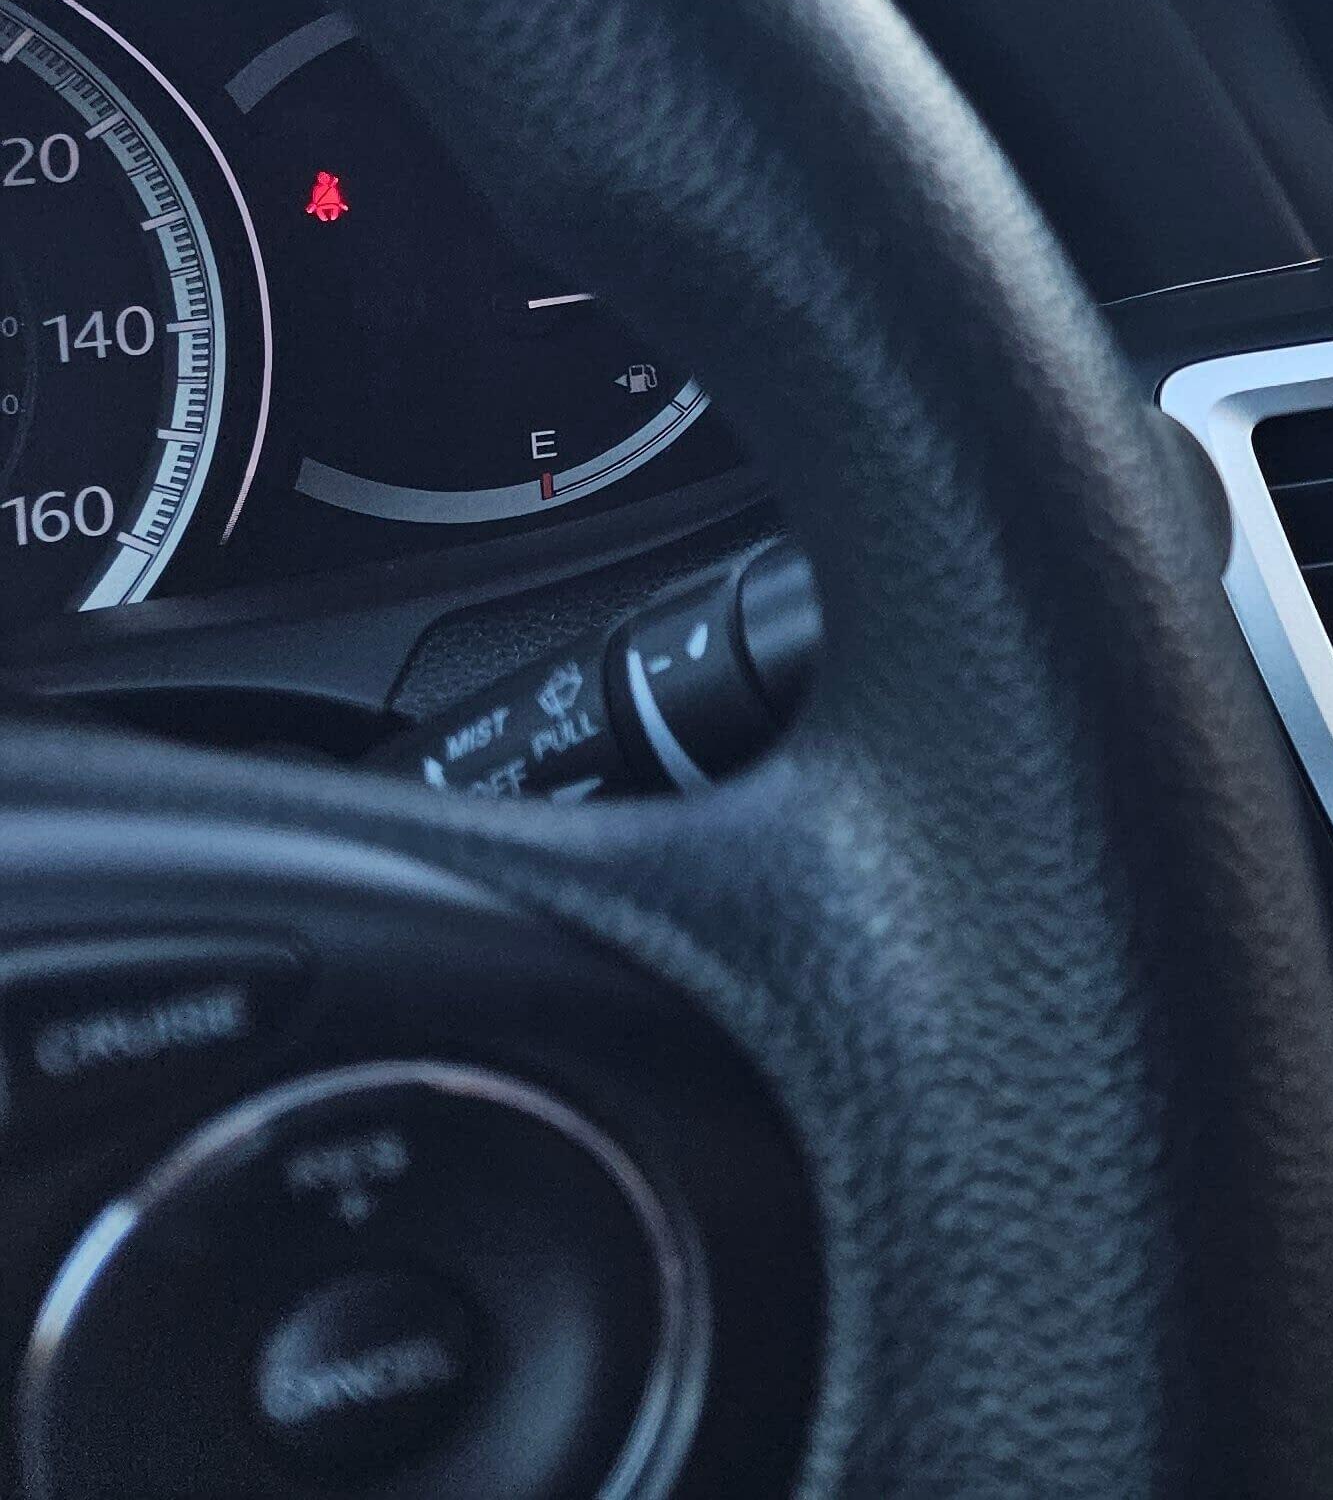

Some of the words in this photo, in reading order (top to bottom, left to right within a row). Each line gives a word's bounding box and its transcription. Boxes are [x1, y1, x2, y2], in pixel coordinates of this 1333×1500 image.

[42, 305, 155, 363] 140
[528, 428, 560, 460] E
[1, 485, 115, 546] 160
